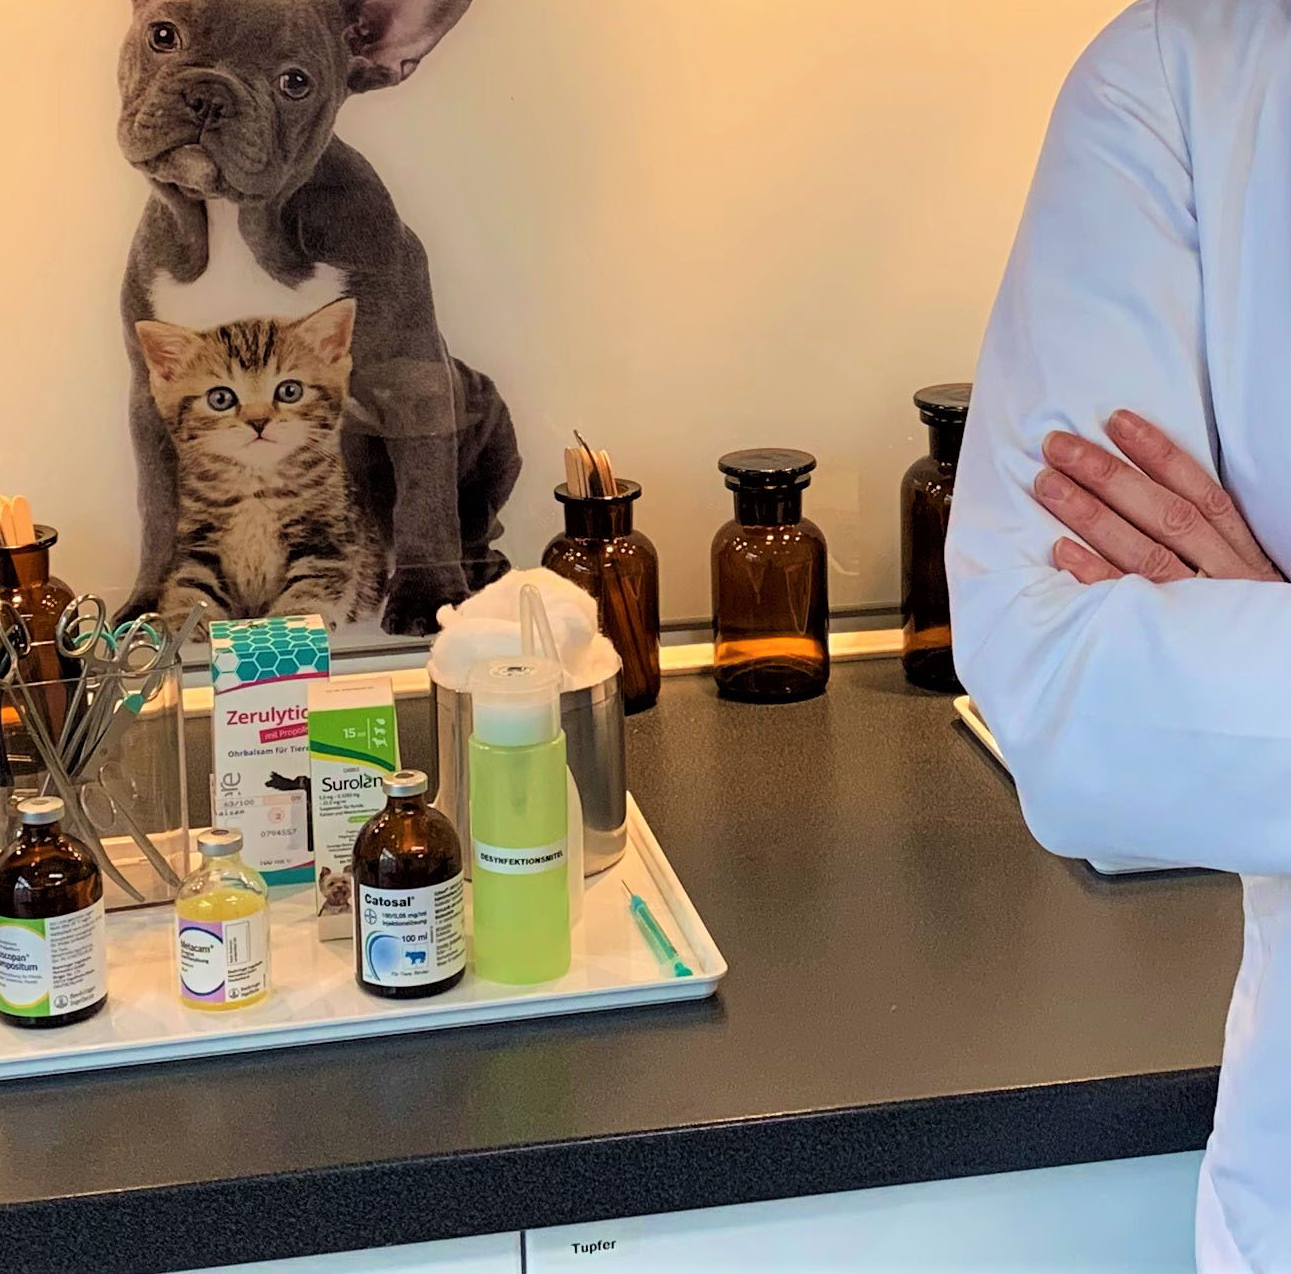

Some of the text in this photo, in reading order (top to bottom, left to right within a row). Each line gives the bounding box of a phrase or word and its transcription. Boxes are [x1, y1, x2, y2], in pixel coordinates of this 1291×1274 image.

[343, 727, 356, 739] 15
[228, 747, 274, 758] Ohrbalsam
[276, 745, 288, 754] für
[364, 893, 411, 907] Catosal
[402, 934, 416, 943] 100
[418, 932, 428, 941] ml
[571, 1239, 617, 1254] Tupfer
